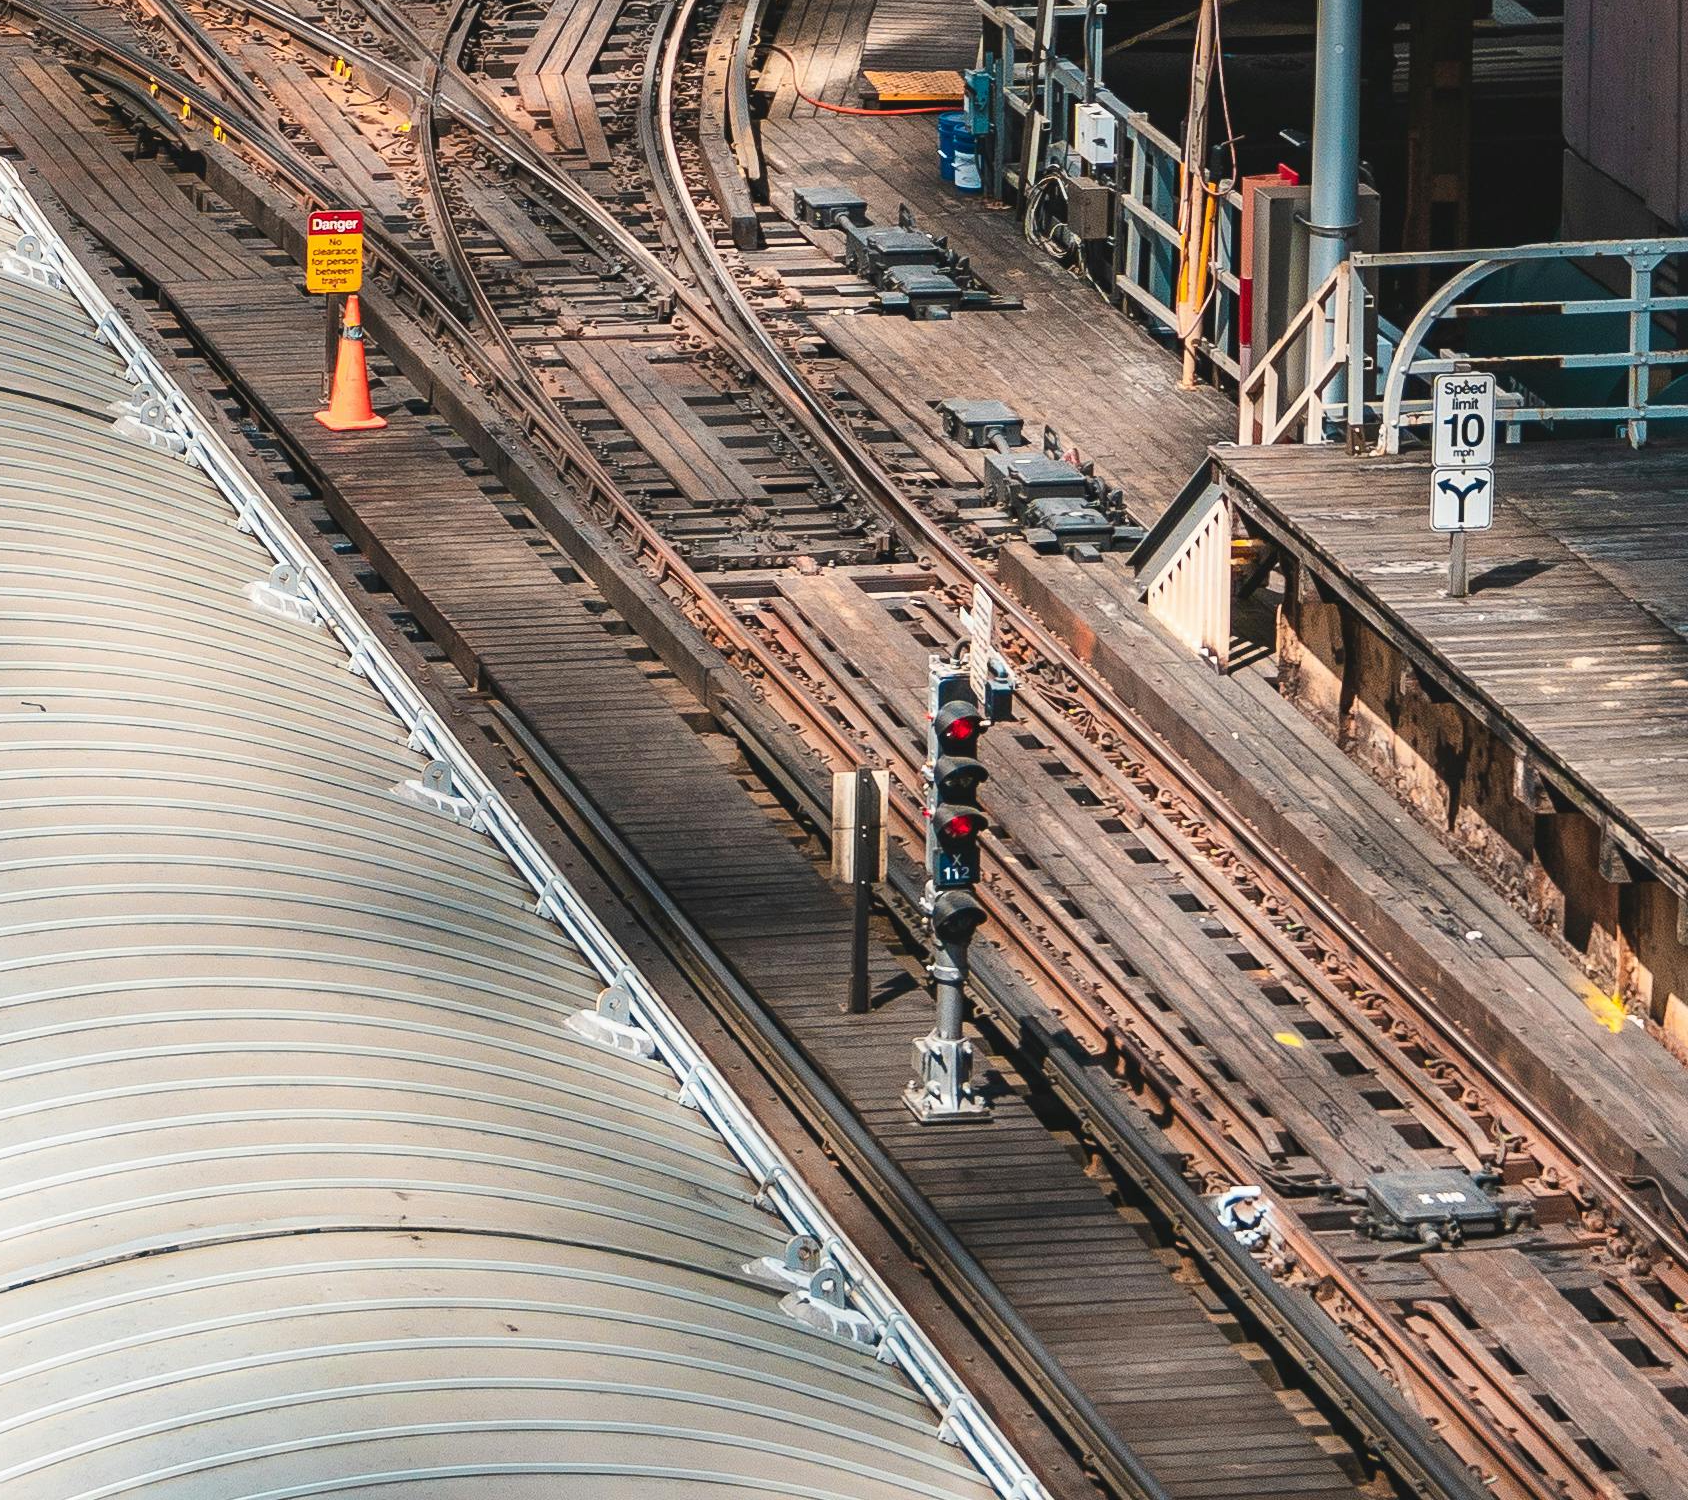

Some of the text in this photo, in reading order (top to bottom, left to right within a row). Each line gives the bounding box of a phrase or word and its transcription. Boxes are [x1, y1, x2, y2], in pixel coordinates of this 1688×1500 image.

[312, 218, 359, 233] Danger
[328, 238, 343, 246] No
[312, 248, 358, 256] clearance
[311, 258, 359, 267] for person
[315, 268, 355, 276] between
[321, 277, 348, 285] trains
[1444, 381, 1488, 398] Speed
[1452, 397, 1479, 410] limit
[1443, 413, 1485, 448] 10
[1453, 449, 1475, 459] mph
[952, 853, 962, 867] X
[943, 866, 970, 880] 112
